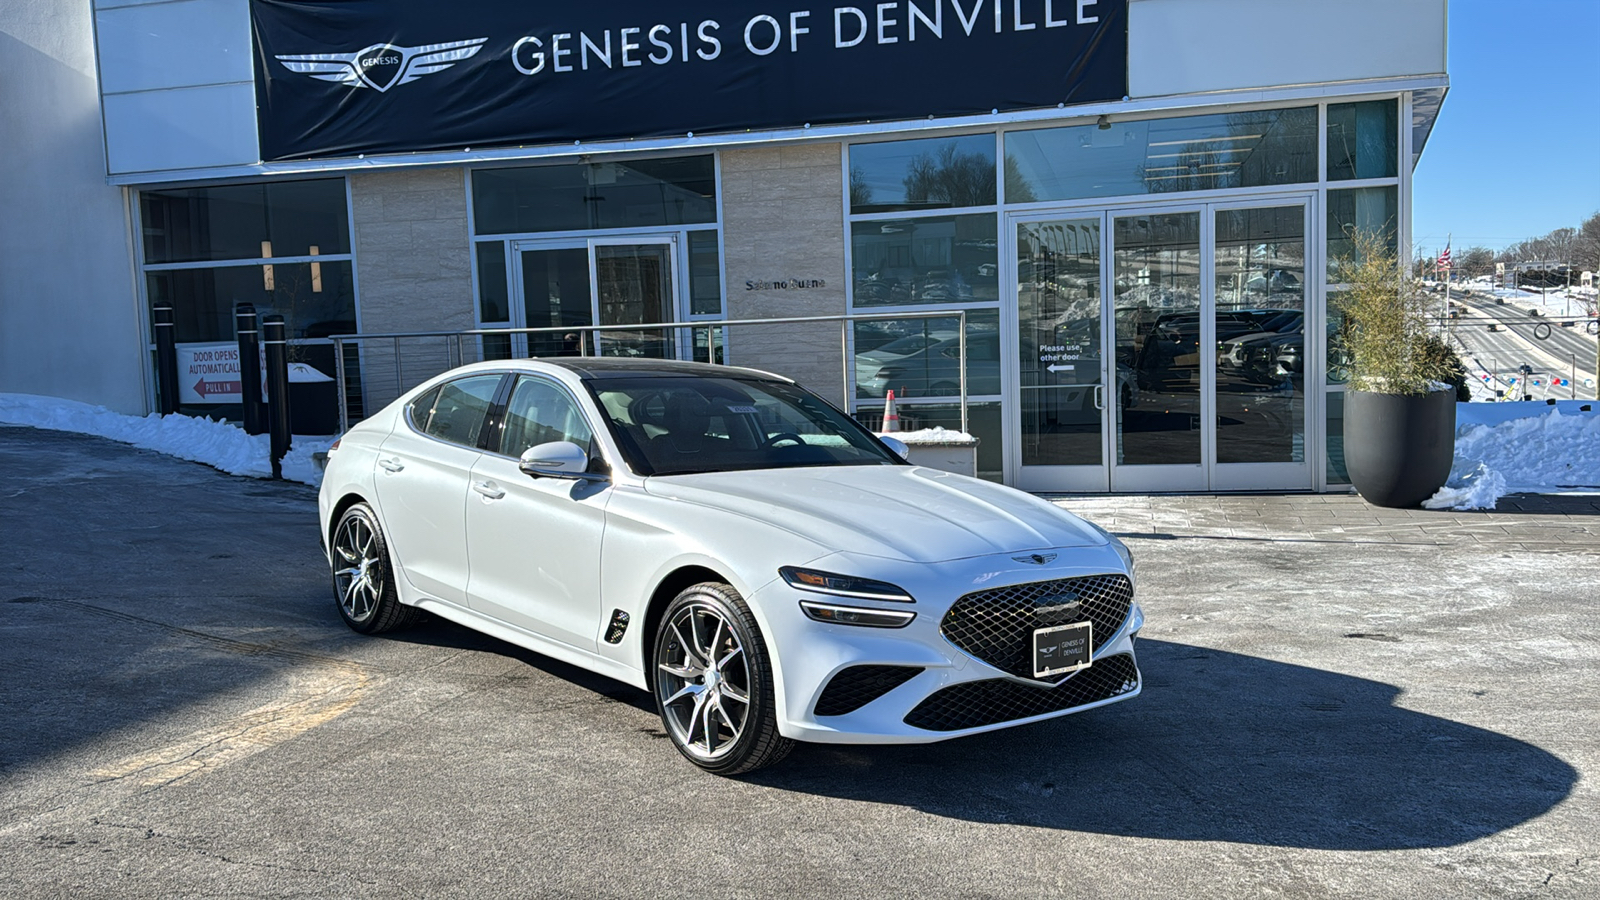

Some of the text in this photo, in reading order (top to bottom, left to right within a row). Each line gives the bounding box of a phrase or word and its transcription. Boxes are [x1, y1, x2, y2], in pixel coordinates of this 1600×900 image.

[511, 0, 1100, 76] GENESIS OF DENVILLE
[362, 55, 399, 67] GENESIS
[193, 349, 239, 362] DOOR OPENS
[189, 362, 241, 375] AUTOMATICALL
[205, 382, 231, 393] PULL IN
[1061, 639, 1078, 648] GENESIS
[1064, 647, 1084, 656] DENVILLE
